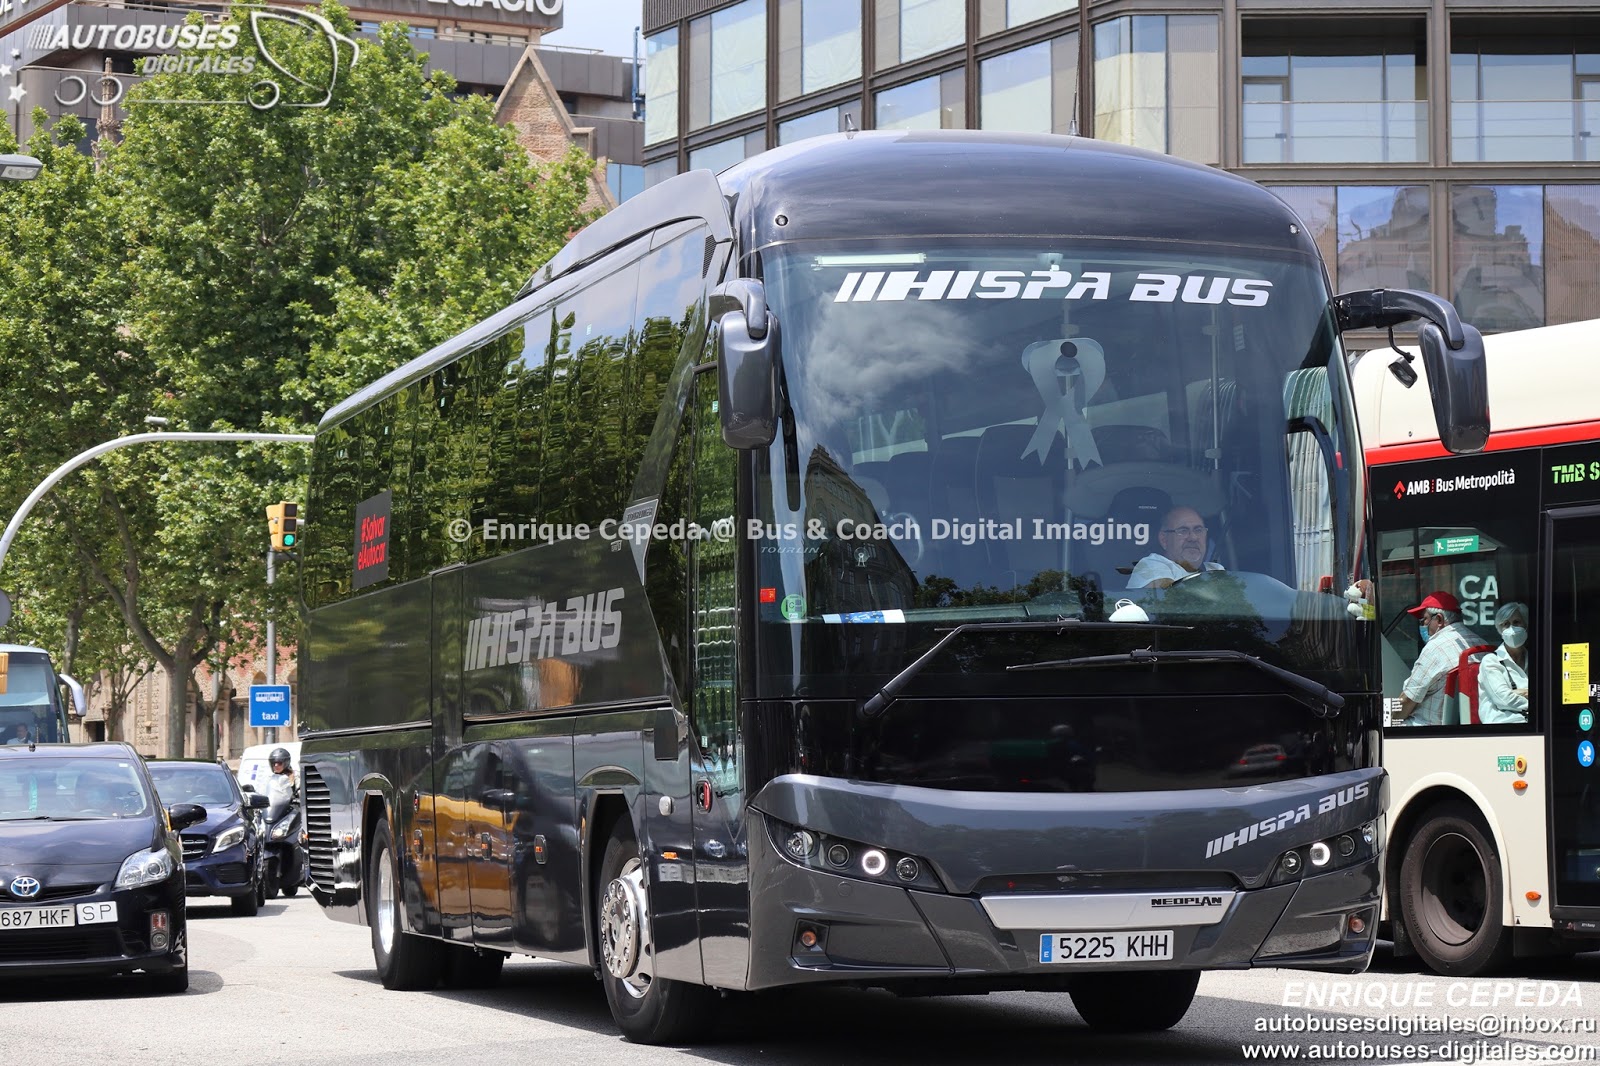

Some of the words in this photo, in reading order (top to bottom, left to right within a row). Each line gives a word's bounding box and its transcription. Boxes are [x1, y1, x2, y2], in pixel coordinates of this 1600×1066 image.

[874, 270, 1111, 301] HISPA
[1128, 273, 1274, 307] BUS
[1406, 479, 1431, 496] AMB
[1435, 478, 1455, 493] Bus
[1455, 468, 1516, 491] Metropolità
[1551, 463, 1586, 484] TMB
[1459, 574, 1499, 600] CA
[1460, 601, 1496, 627] SE
[477, 601, 558, 670] HISPA
[561, 587, 625, 656] BUS
[261, 711, 279, 721] taxi
[1222, 803, 1312, 853] HISPA
[1318, 781, 1370, 815] BUS
[82, 904, 112, 922] SP
[1151, 896, 1223, 907] NEOPLAN
[39, 908, 70, 925] HKF
[1059, 936, 1116, 959] 5225
[1127, 934, 1169, 958] KHH
